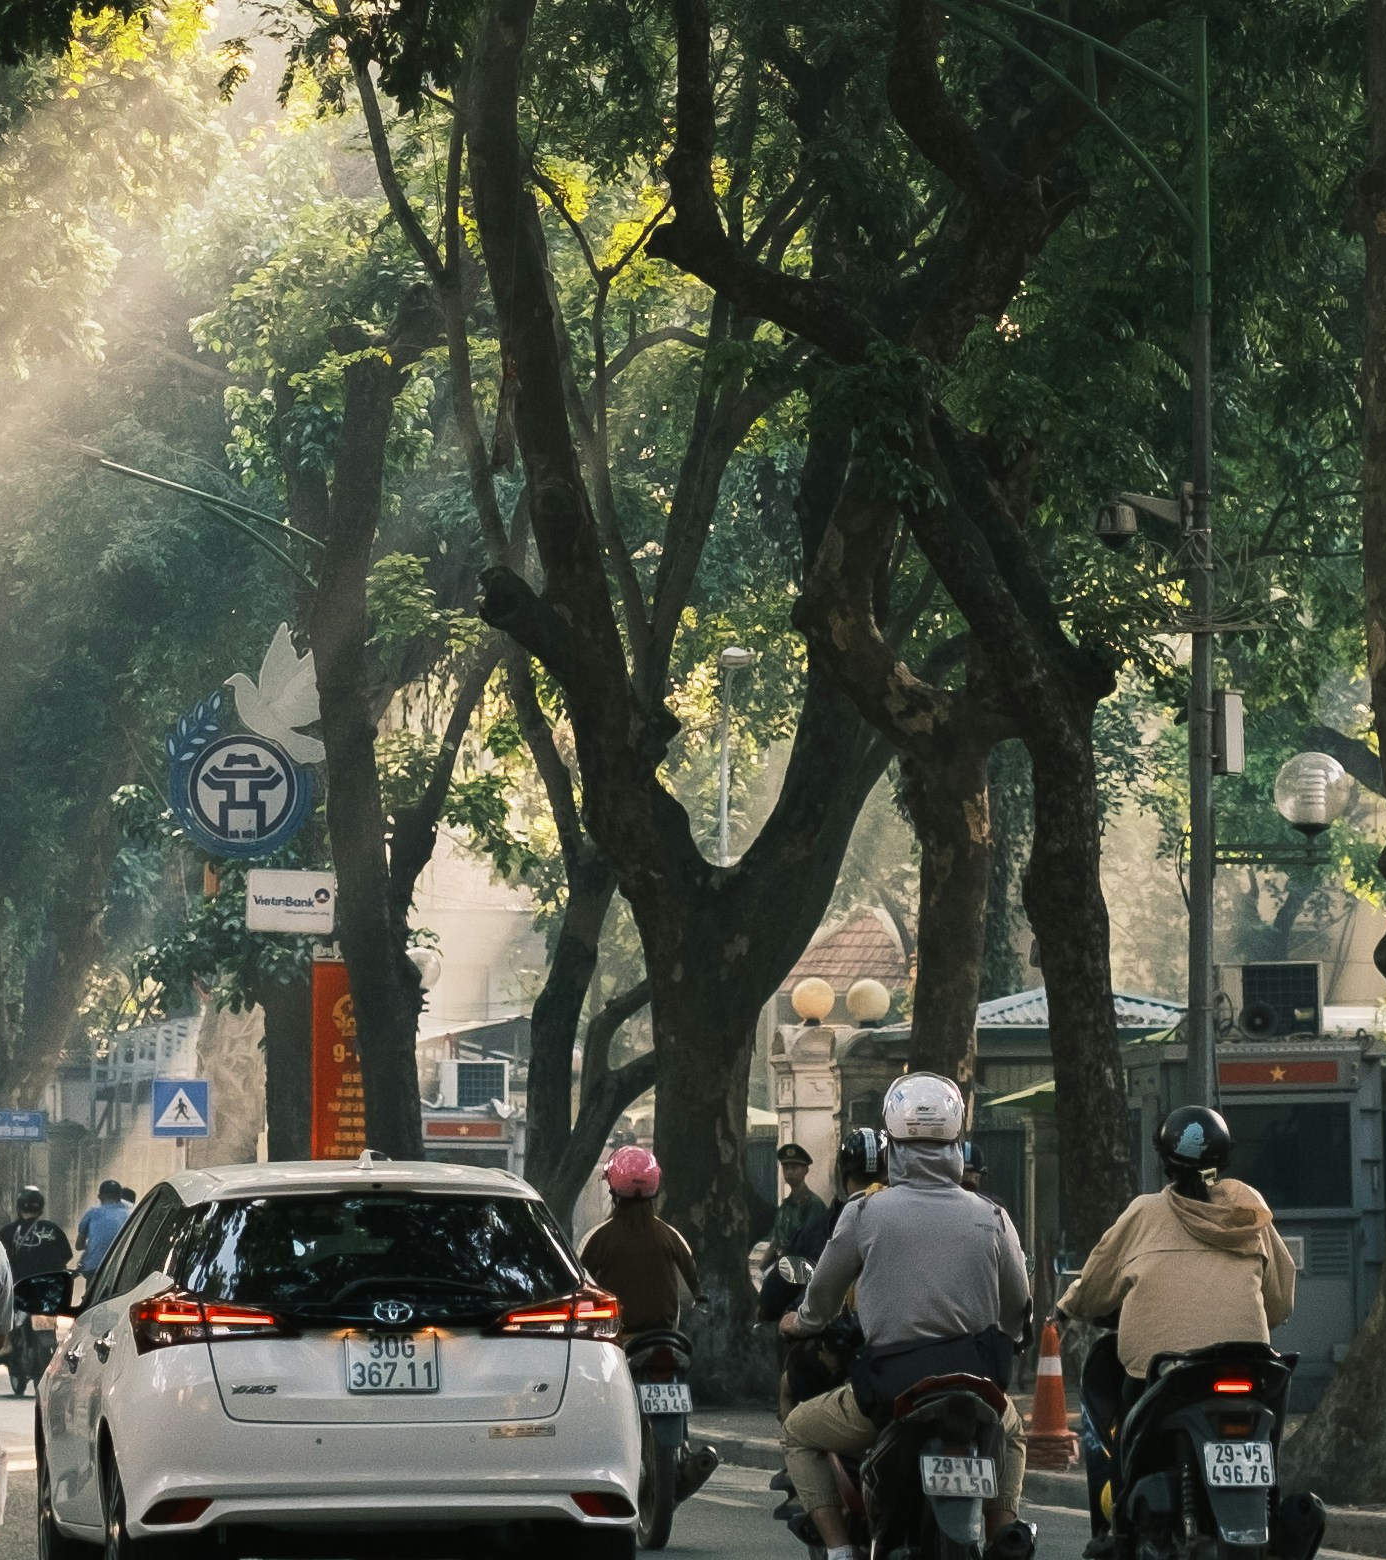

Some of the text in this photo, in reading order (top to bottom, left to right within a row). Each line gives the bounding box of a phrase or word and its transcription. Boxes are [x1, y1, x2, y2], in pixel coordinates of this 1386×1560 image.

[369, 1334, 416, 1359] 30G
[352, 1361, 433, 1388] 367.11
[1215, 1444, 1263, 1464] 29-V5
[1212, 1465, 1270, 1484] 496.76
